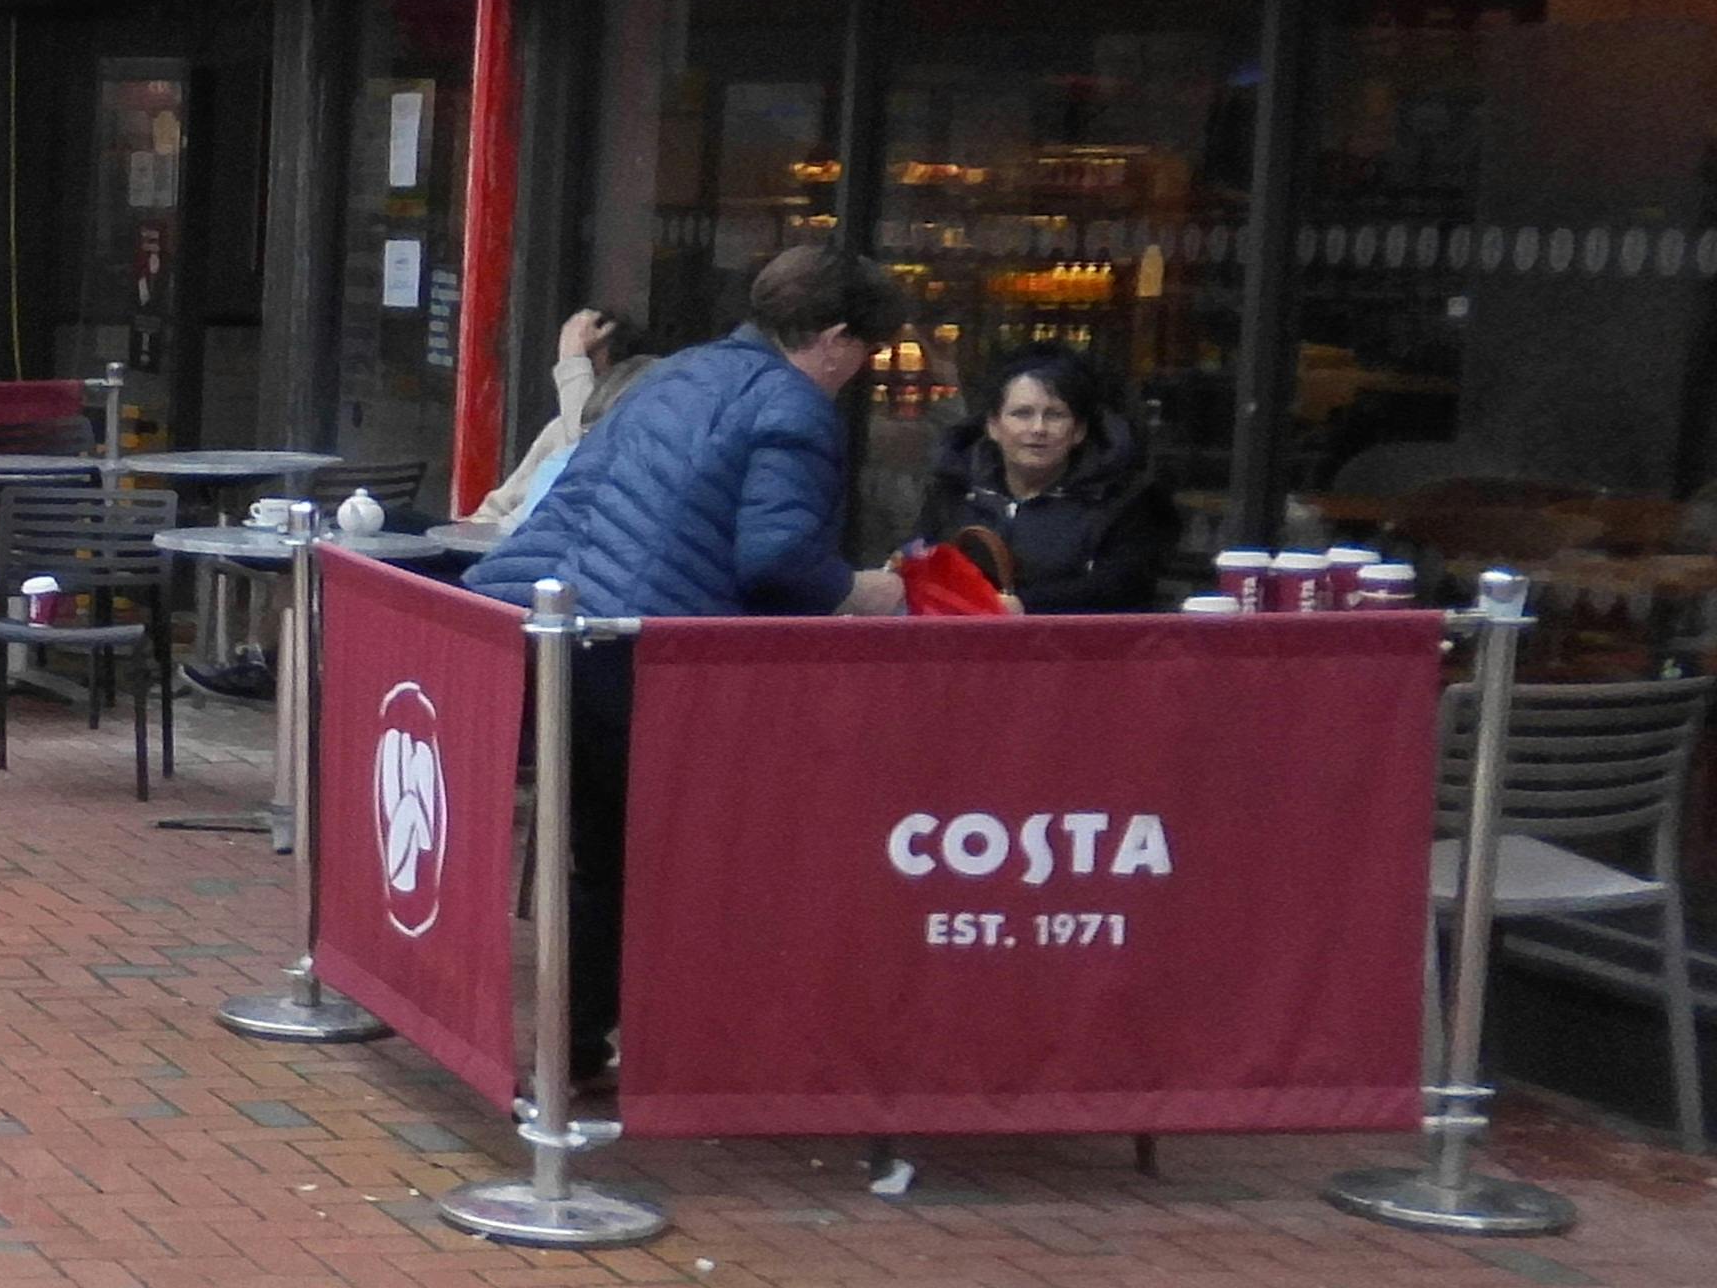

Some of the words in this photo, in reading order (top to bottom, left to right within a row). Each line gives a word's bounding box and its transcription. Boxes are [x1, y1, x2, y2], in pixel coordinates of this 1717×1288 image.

[887, 812, 1174, 885] COSTA
[925, 912, 1017, 948] EST.
[1033, 913, 1126, 947] 1971
